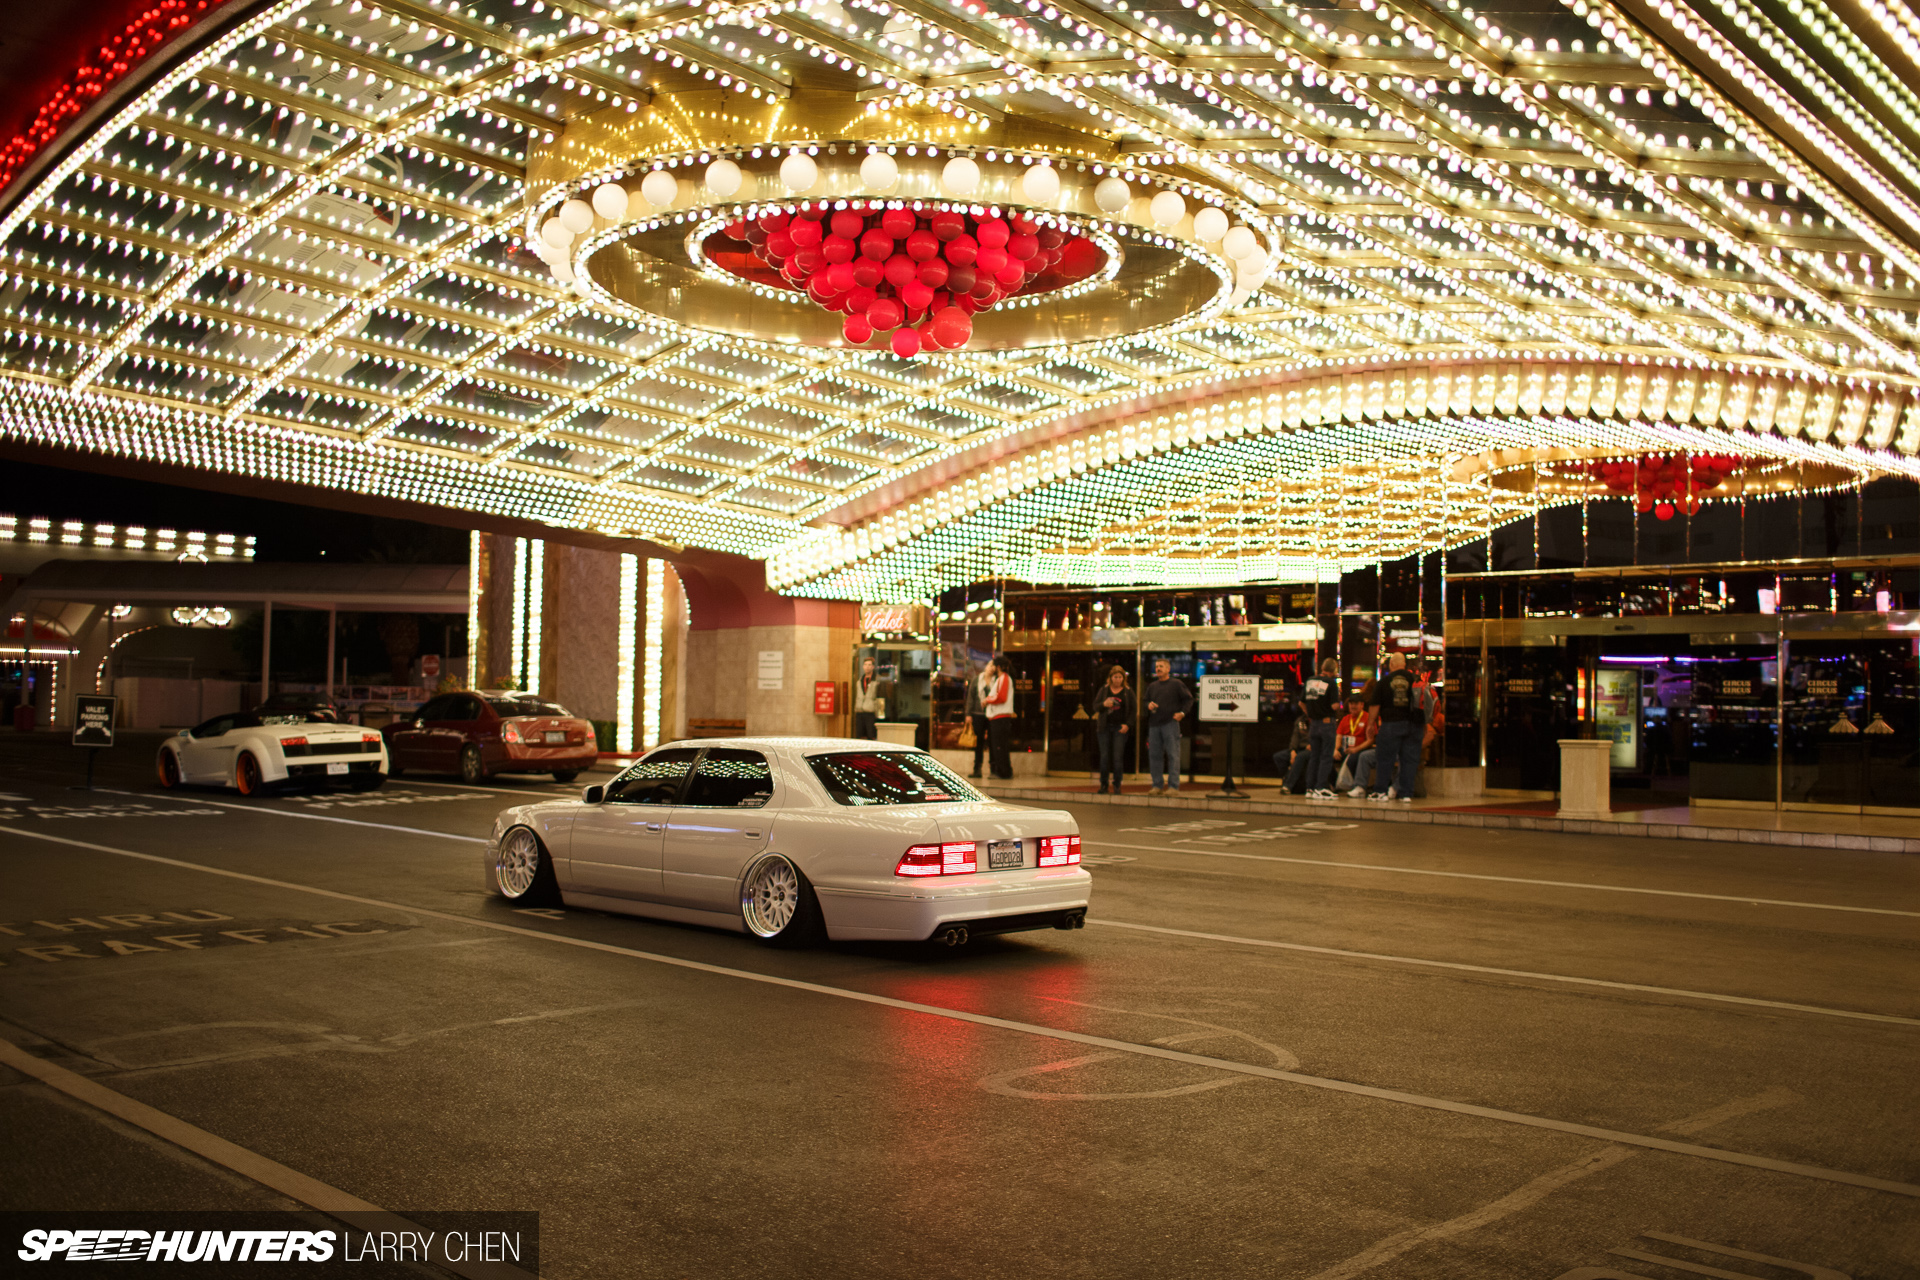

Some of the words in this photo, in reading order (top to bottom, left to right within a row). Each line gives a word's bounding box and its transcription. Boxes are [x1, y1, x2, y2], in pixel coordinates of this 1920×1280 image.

[864, 609, 905, 630] Valet
[80, 713, 109, 721] PARKING
[0, 922, 389, 966] RAFFIC
